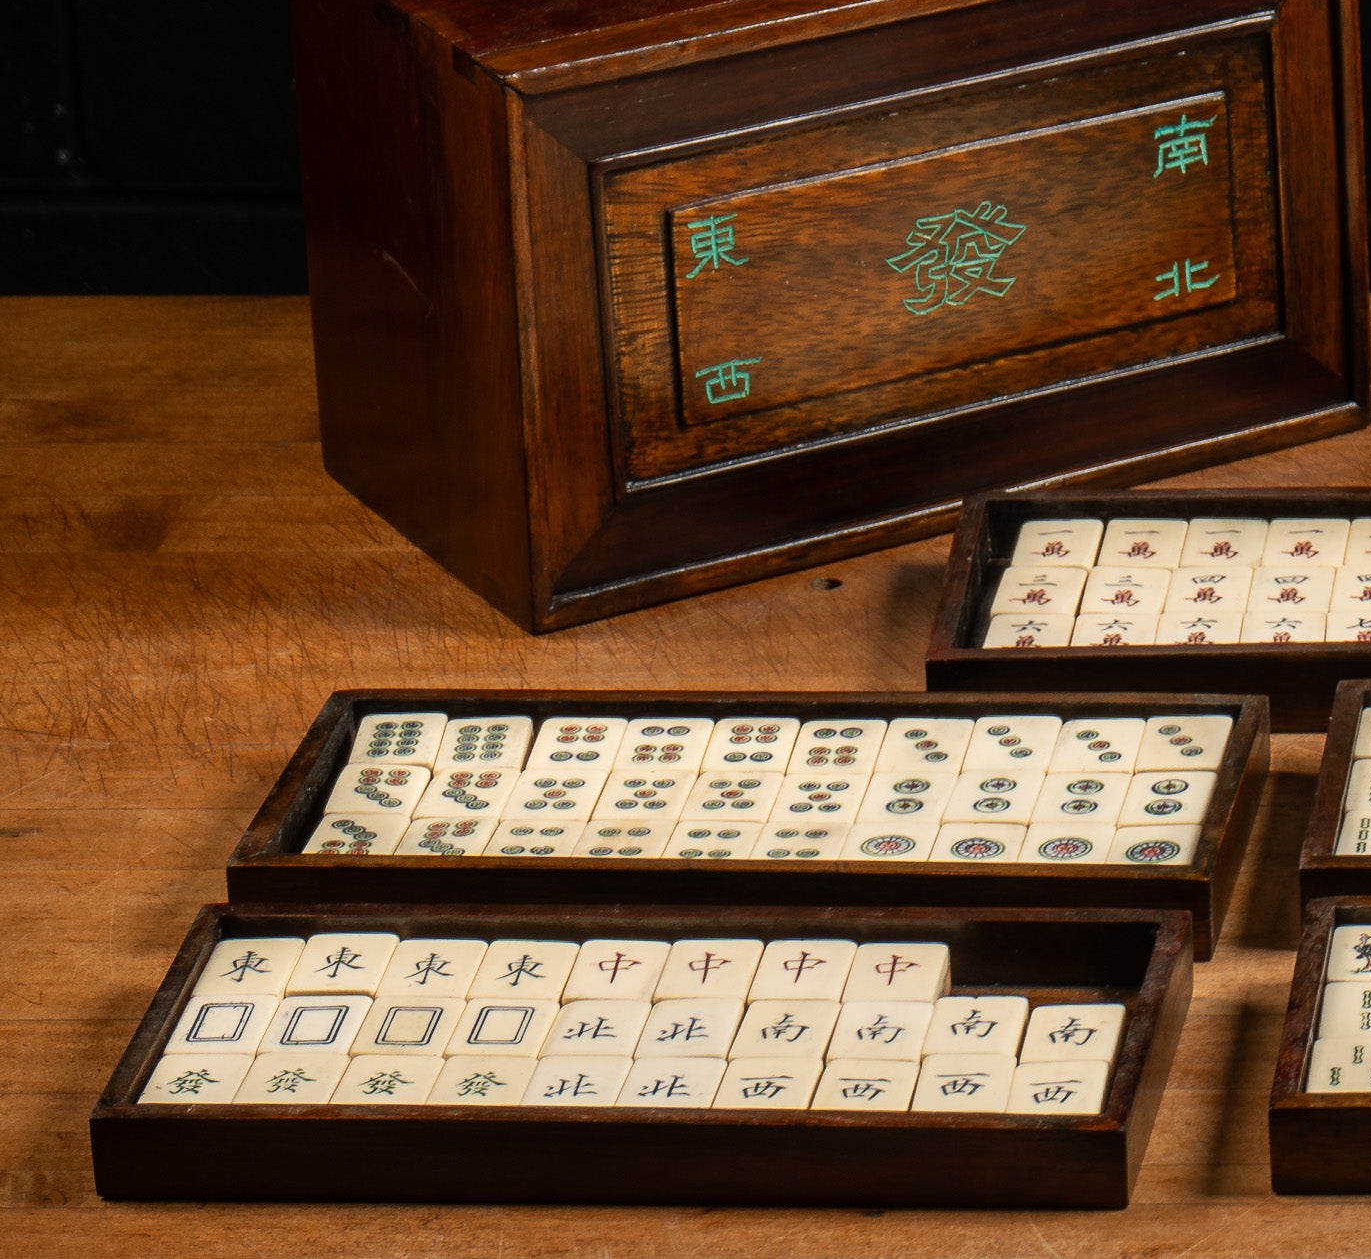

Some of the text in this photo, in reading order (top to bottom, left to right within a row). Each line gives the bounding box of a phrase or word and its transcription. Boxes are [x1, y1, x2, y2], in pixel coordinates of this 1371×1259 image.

[1152, 114, 1217, 179] 南
[684, 213, 749, 279] 東
[884, 199, 1028, 316] 發
[1154, 259, 1218, 301] 北
[694, 357, 762, 405] 西
[217, 948, 272, 983] 東
[315, 946, 366, 979] 東
[404, 952, 454, 986] 東
[495, 954, 546, 987] 東
[598, 951, 643, 985] 中
[688, 951, 732, 985] 中
[782, 950, 828, 984] 中
[874, 953, 919, 986] 中
[562, 1016, 617, 1040] 北
[655, 1016, 709, 1042] 北
[760, 1012, 811, 1043] 南
[856, 1014, 906, 1044] 南
[950, 1008, 999, 1038] 南
[1048, 1016, 1098, 1046] 南
[166, 1068, 221, 1095] 發
[265, 1067, 317, 1094] 發
[358, 1070, 415, 1096] 發
[456, 1071, 508, 1097] 發
[543, 1073, 598, 1098] 北
[637, 1074, 691, 1099] 北
[740, 1075, 794, 1099] 西
[838, 1077, 892, 1101] 西
[936, 1072, 989, 1097] 西
[1030, 1079, 1082, 1105] 西
